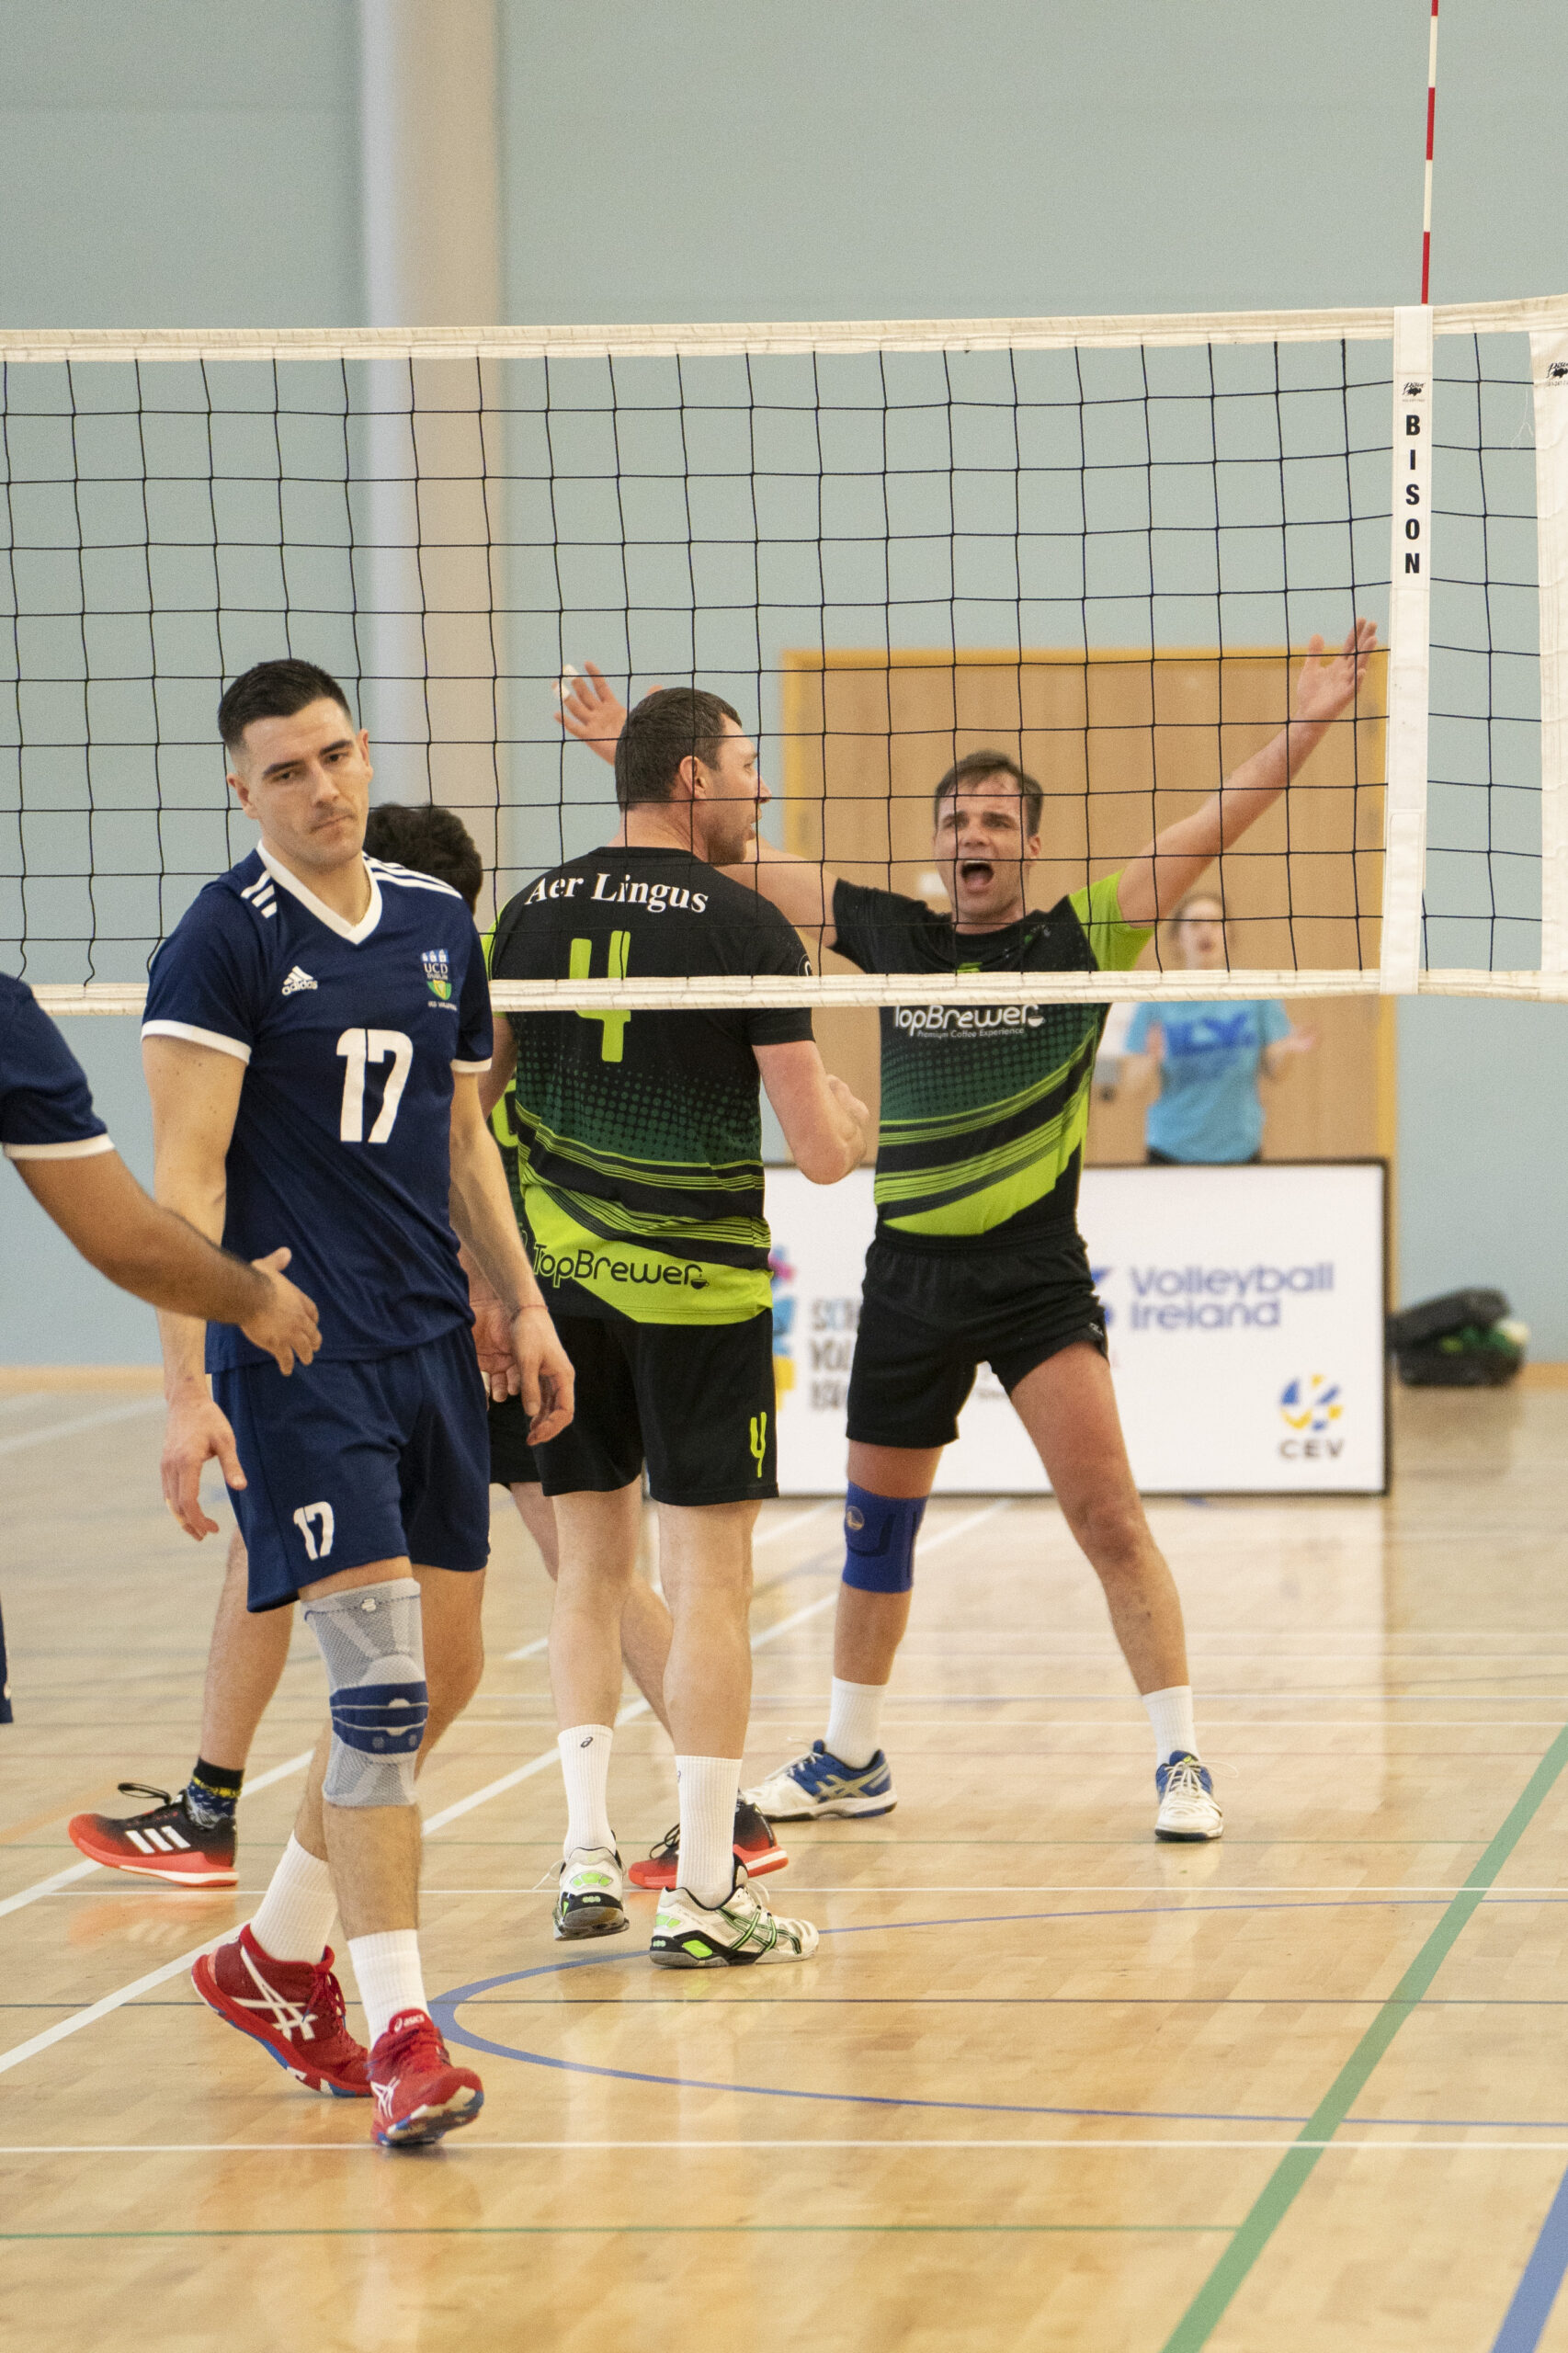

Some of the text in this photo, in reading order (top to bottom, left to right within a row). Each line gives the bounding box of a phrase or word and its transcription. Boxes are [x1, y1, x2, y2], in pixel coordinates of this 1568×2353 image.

[1404, 414, 1421, 574] BISON
[524, 872, 710, 914] Aer Lingus
[424, 962, 449, 974] UCD
[281, 980, 318, 996] adidas
[979, 1026, 1026, 1037] Experience
[335, 1027, 414, 1144] 17
[532, 1244, 704, 1289] TopBrewer
[1130, 1263, 1335, 1299] Volleyball
[1131, 1301, 1281, 1329] Ireland
[1279, 1438, 1345, 1460] CEV
[293, 1501, 335, 1561] 17
